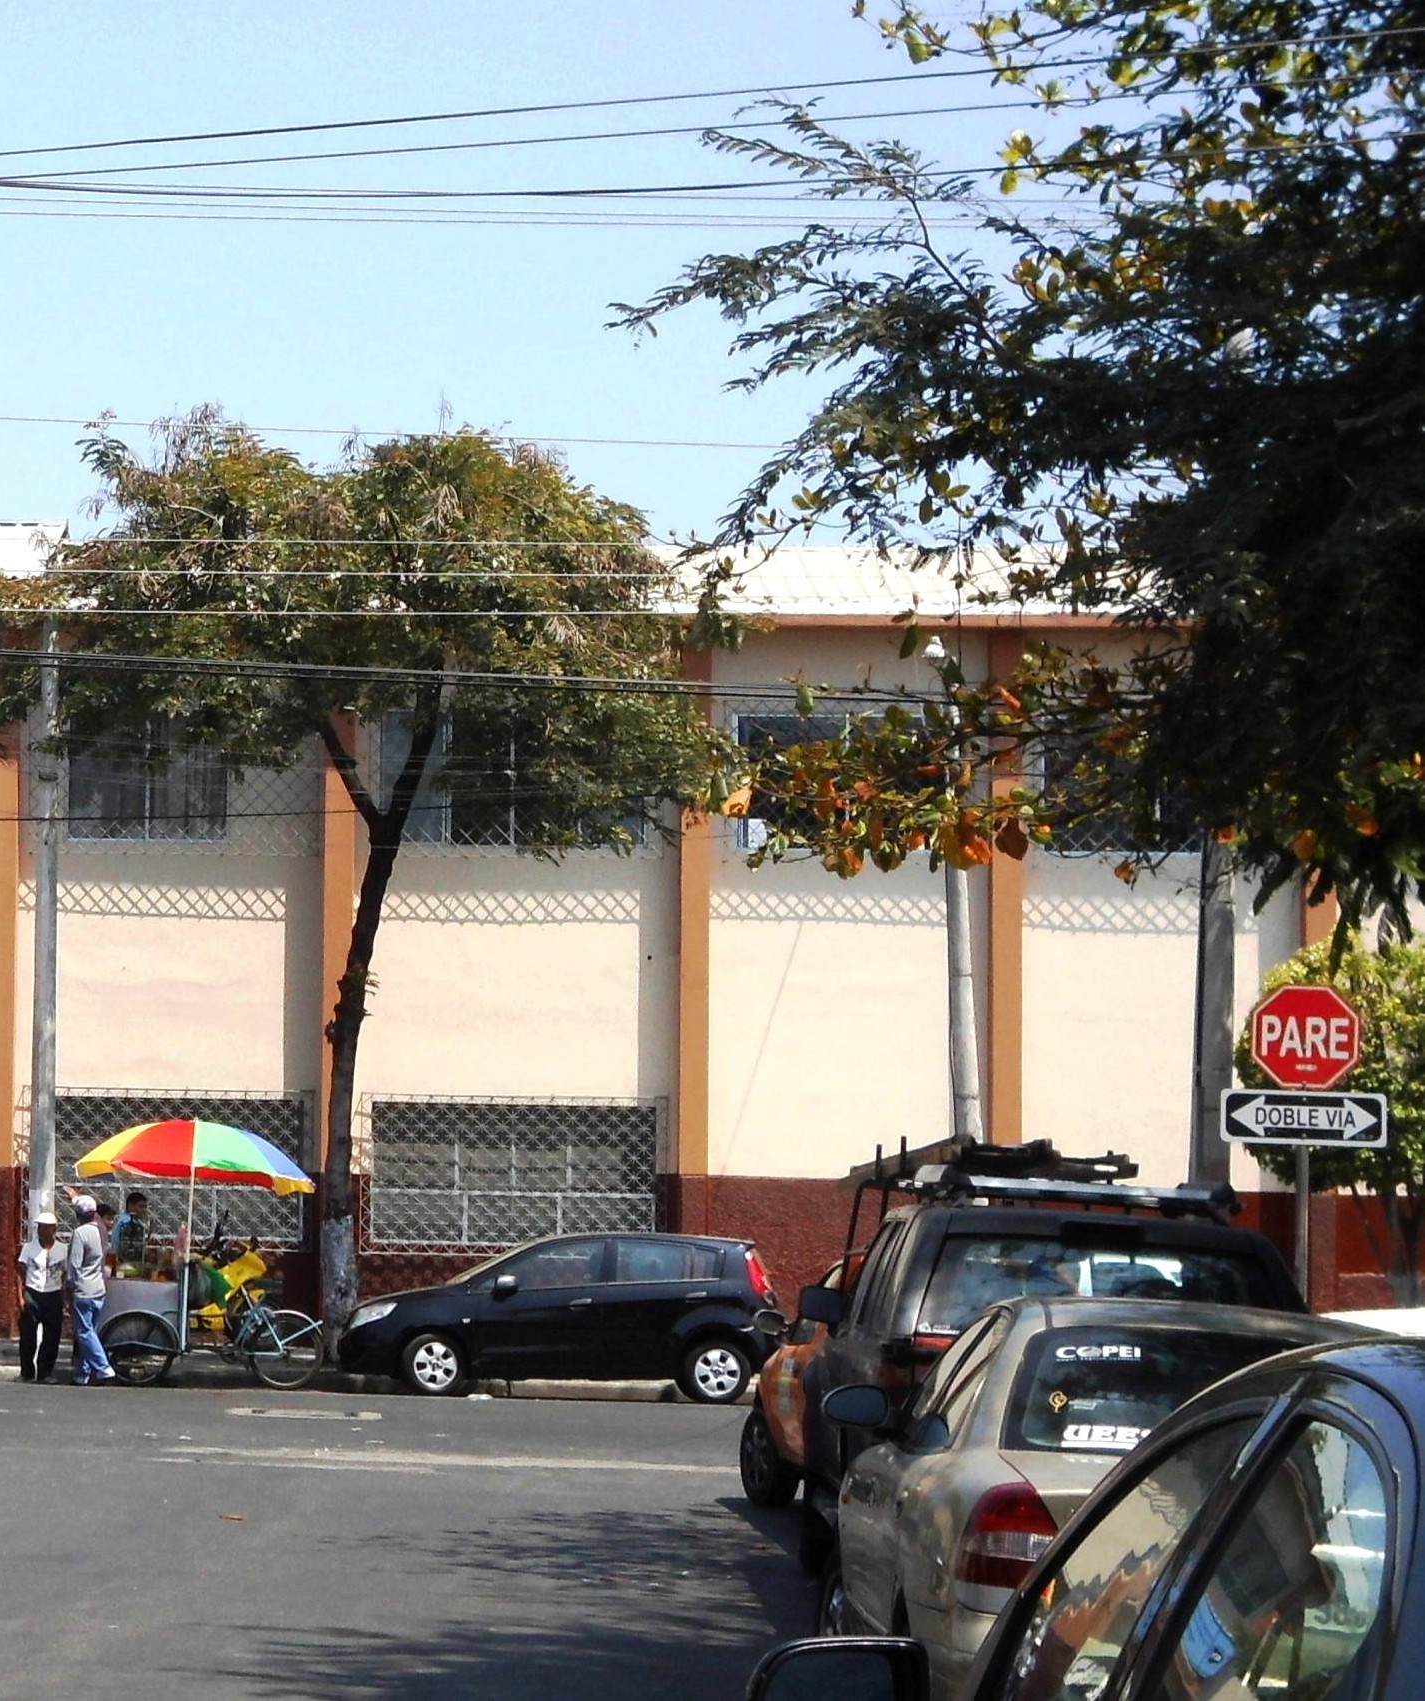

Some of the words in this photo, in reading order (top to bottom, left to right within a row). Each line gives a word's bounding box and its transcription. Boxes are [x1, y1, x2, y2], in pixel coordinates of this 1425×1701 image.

[1261, 1014, 1350, 1060] PARE
[1254, 1106, 1319, 1127] DOBLE
[1326, 1109, 1357, 1128] VIA
[1055, 1345, 1142, 1359] COPEI
